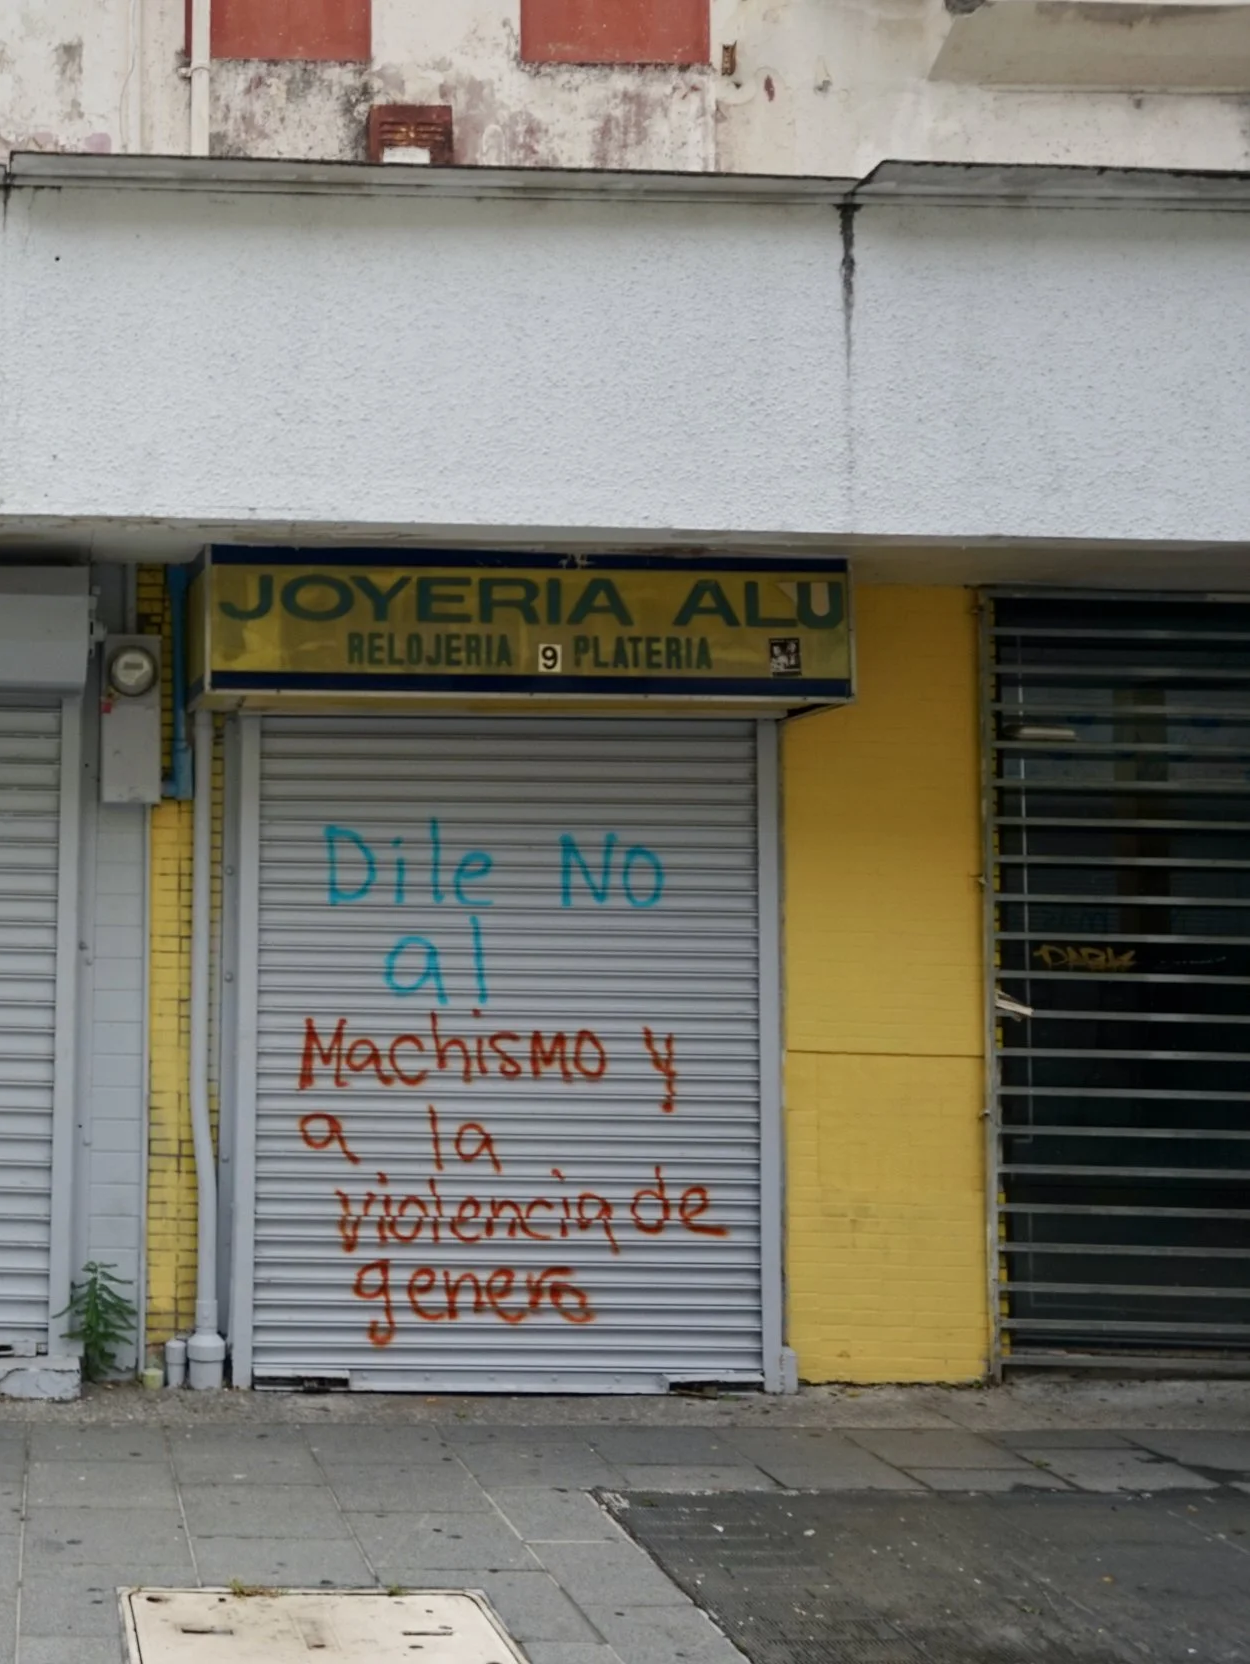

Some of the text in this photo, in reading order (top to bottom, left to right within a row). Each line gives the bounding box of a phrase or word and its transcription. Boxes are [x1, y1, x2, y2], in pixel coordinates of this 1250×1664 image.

[218, 573, 844, 631] JOYERIA ALU
[348, 631, 712, 671] RELOJERIA PLATERIA
[541, 645, 558, 671] 9
[323, 816, 665, 908] Dile NO
[383, 914, 489, 1006] al
[299, 1104, 502, 1174] a la
[353, 1258, 598, 1349] genero
